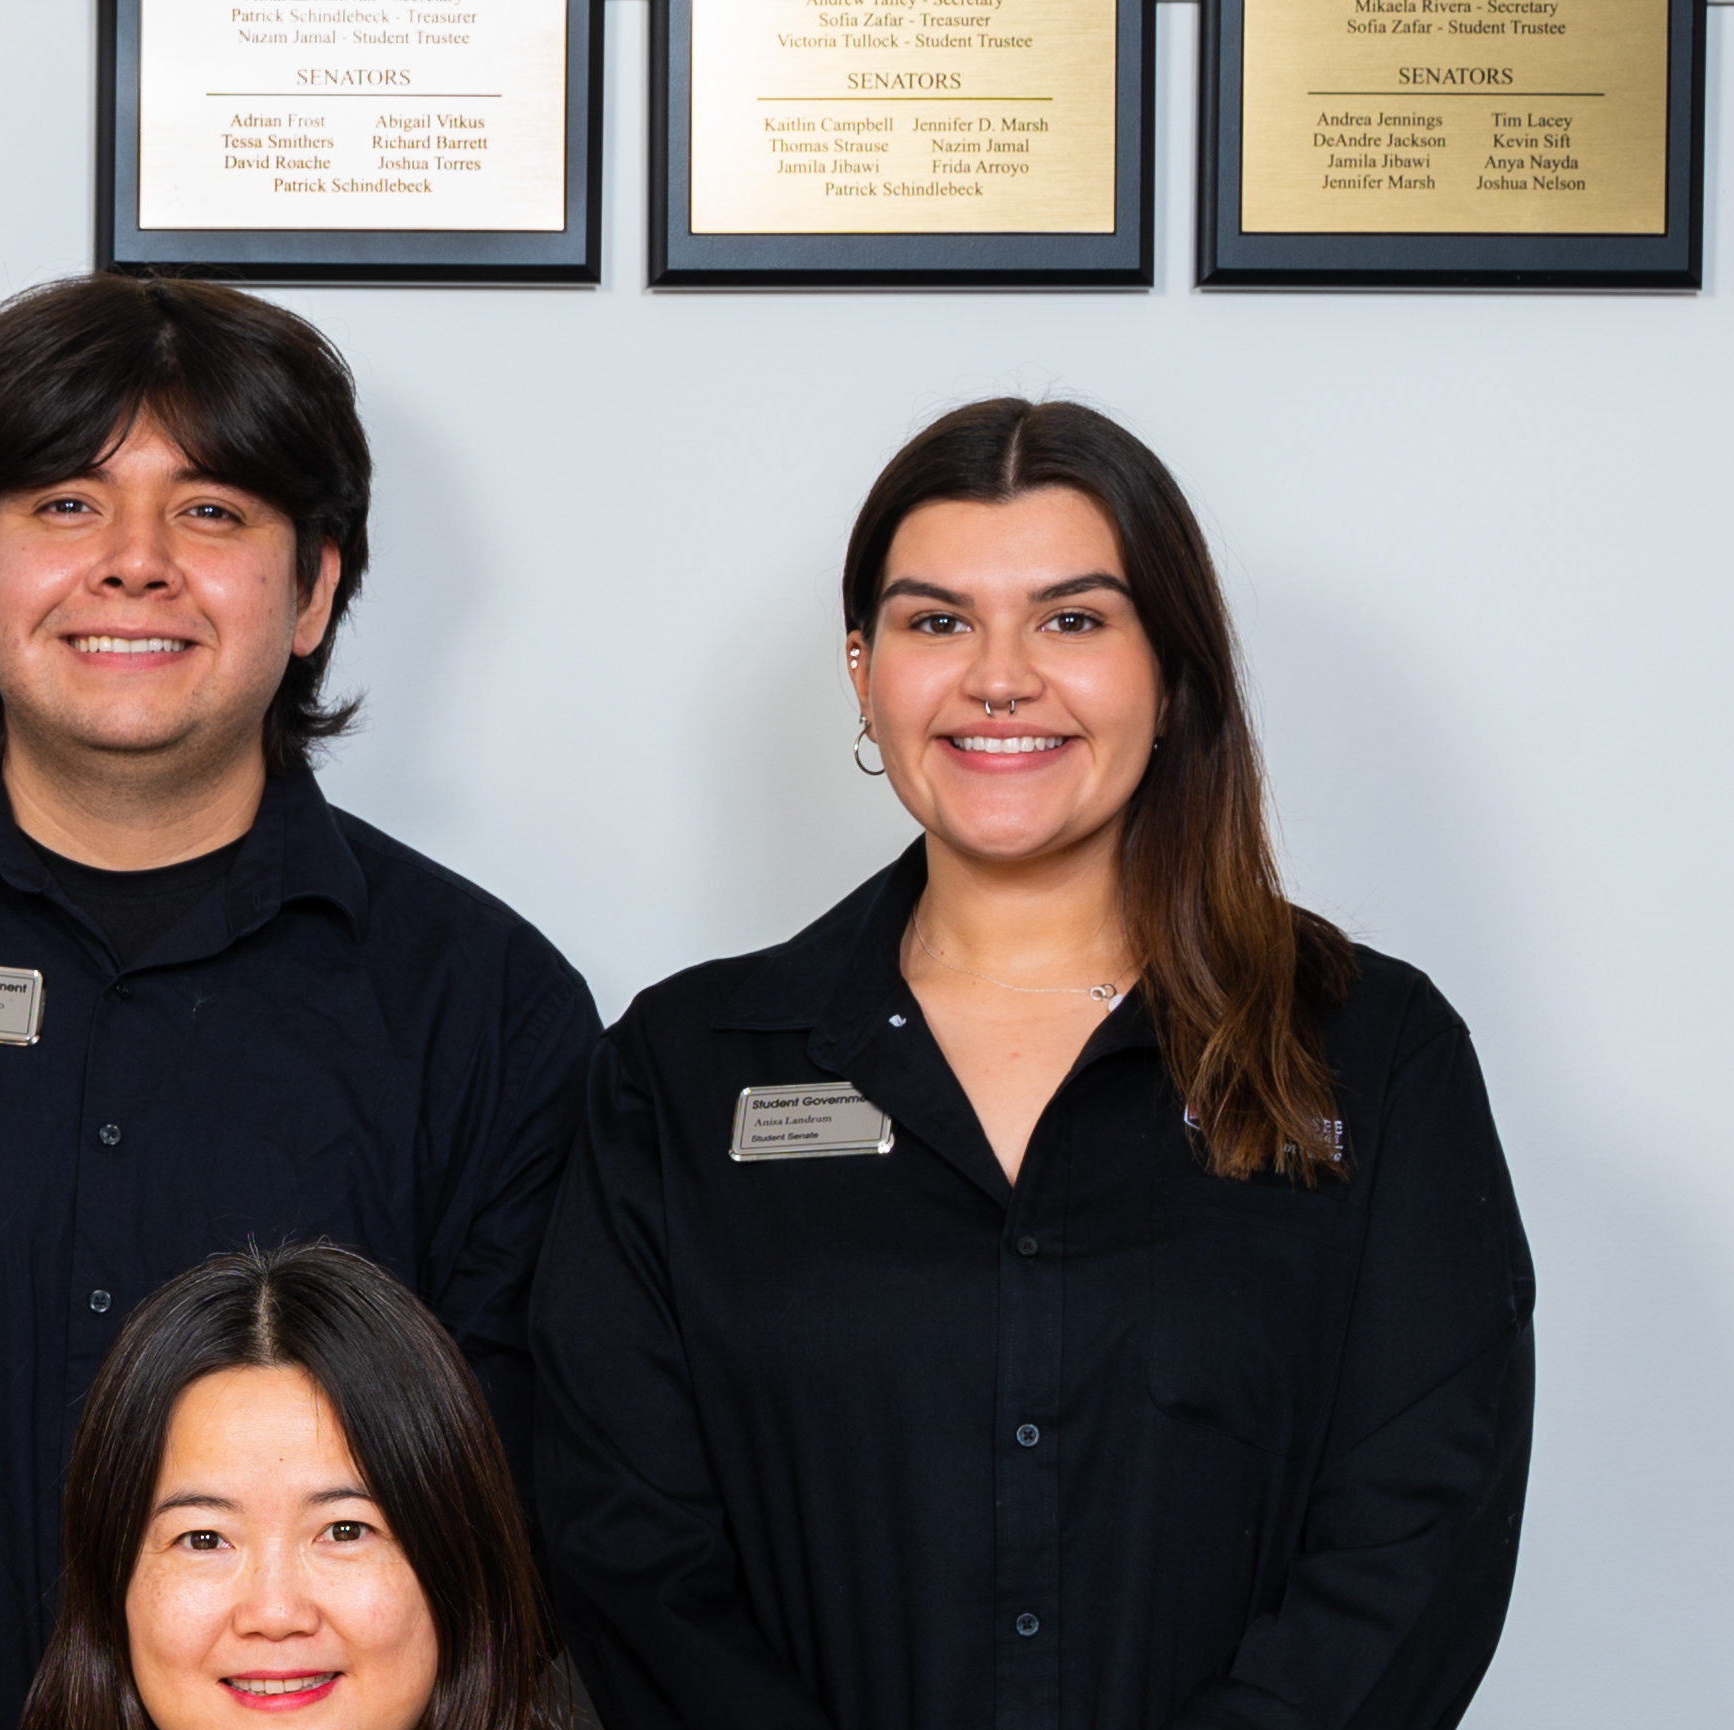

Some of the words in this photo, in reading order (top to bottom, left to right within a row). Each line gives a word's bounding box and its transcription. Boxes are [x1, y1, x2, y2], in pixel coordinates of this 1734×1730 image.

[1347, 21, 1386, 34] Sofia
[1391, 21, 1432, 34] Zafar
[1448, 21, 1506, 35] Student
[1510, 21, 1566, 35] Trustee
[297, 69, 411, 86] SENATORS
[848, 73, 961, 90] SENATORS
[1399, 68, 1514, 86] SENATORS
[764, 118, 816, 132] Kaitlin
[821, 118, 893, 135] Campbell
[912, 118, 973, 133] Jennifer
[978, 118, 996, 133] D.
[1001, 118, 1049, 133] Marsh
[1317, 113, 1372, 127] Andrea
[1377, 113, 1443, 130] Jennings
[1492, 113, 1521, 127] Tim
[1528, 114, 1573, 131] Lacey
[932, 139, 981, 153] Nazim
[986, 139, 1029, 154] Jamal
[1313, 133, 1382, 148] DeAndre
[1386, 133, 1446, 149] Jackson
[1493, 135, 1538, 149] Kevin
[224, 156, 270, 170] David
[275, 156, 331, 170] Roache
[378, 157, 429, 171] Joshua
[434, 157, 481, 171] Torres
[932, 160, 970, 175] Frida
[975, 161, 1029, 177] Arroyo
[1327, 155, 1376, 168] Jamila
[1382, 155, 1430, 169] Jibawi
[1485, 156, 1525, 172] Anya
[1530, 156, 1579, 172] Nayda
[274, 178, 327, 193] Patrick
[332, 178, 432, 193] Schindlebeck
[825, 182, 877, 197] Patrick
[882, 182, 983, 197] Schindlebeck
[1322, 175, 1382, 190] Jennifer
[1387, 176, 1435, 190] Marsh
[1476, 177, 1528, 191] Joshua
[1533, 177, 1586, 191] Nelson
[752, 1098, 800, 1110] Student
[802, 1094, 870, 1107] Governme
[785, 1115, 832, 1125] Landrum
[751, 1134, 785, 1142] Student
[787, 1132, 819, 1140] Senate
